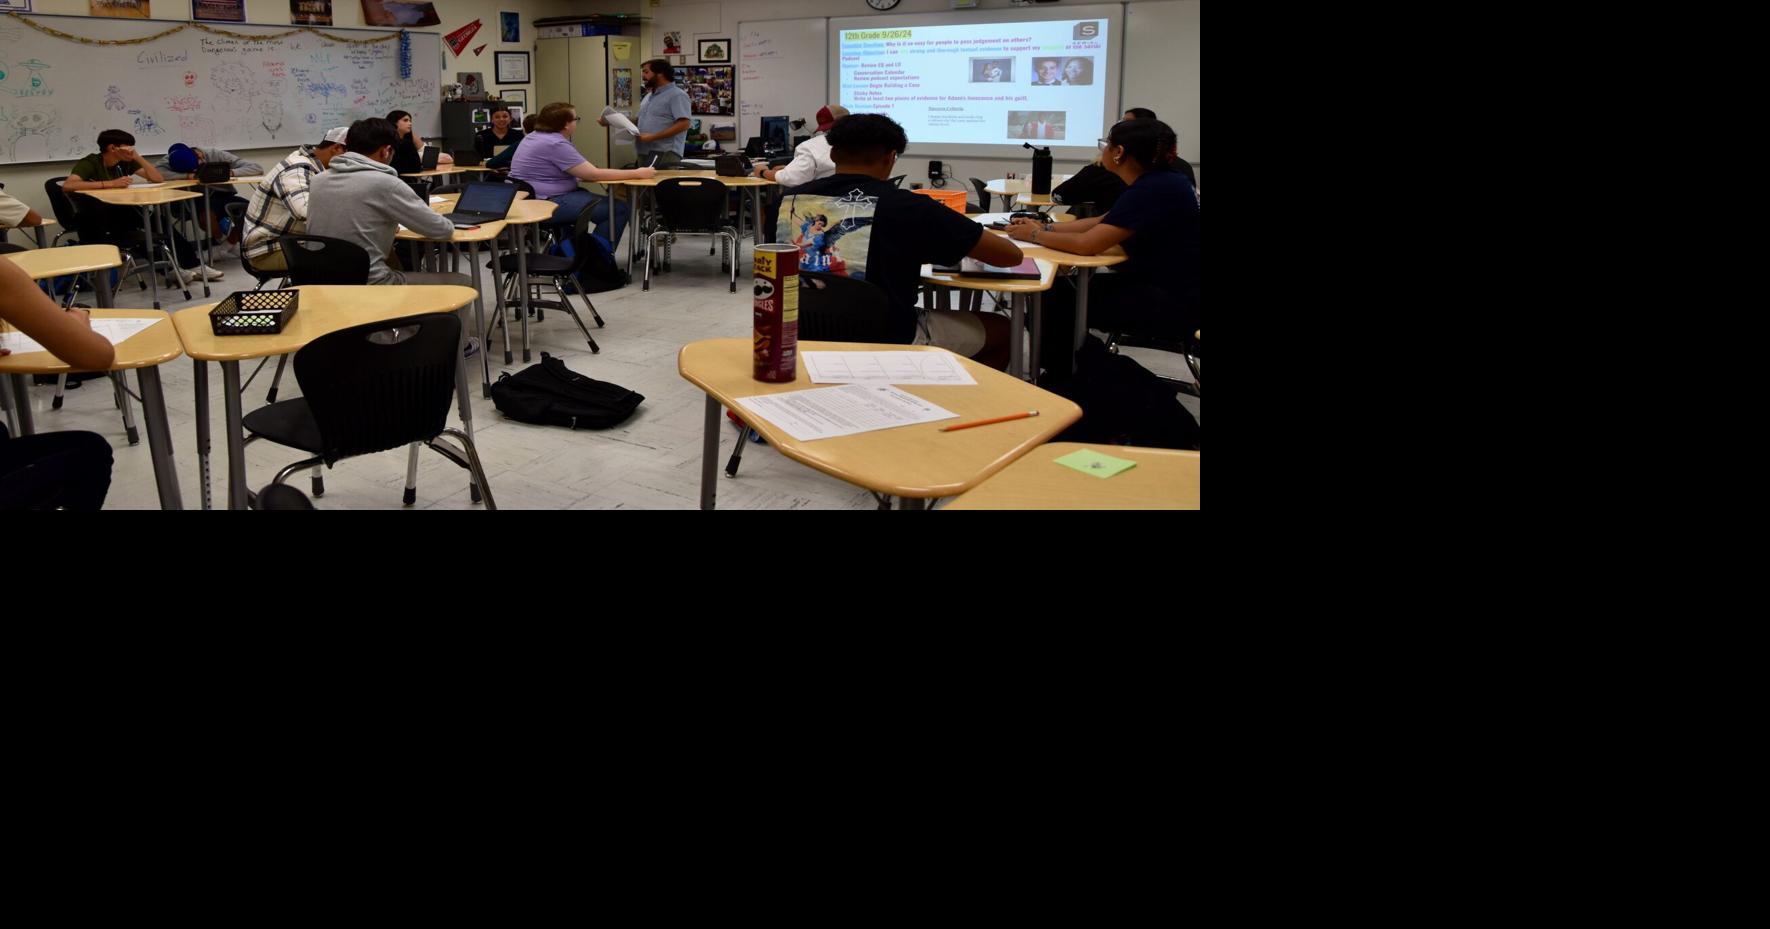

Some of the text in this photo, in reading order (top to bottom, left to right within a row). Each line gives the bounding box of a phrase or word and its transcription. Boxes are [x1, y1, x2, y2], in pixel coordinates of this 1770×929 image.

[845, 29, 912, 41] 12th Grade 9/26/24
[1082, 25, 1096, 35] S
[136, 50, 188, 65] Civilized
[800, 251, 832, 267] ain
